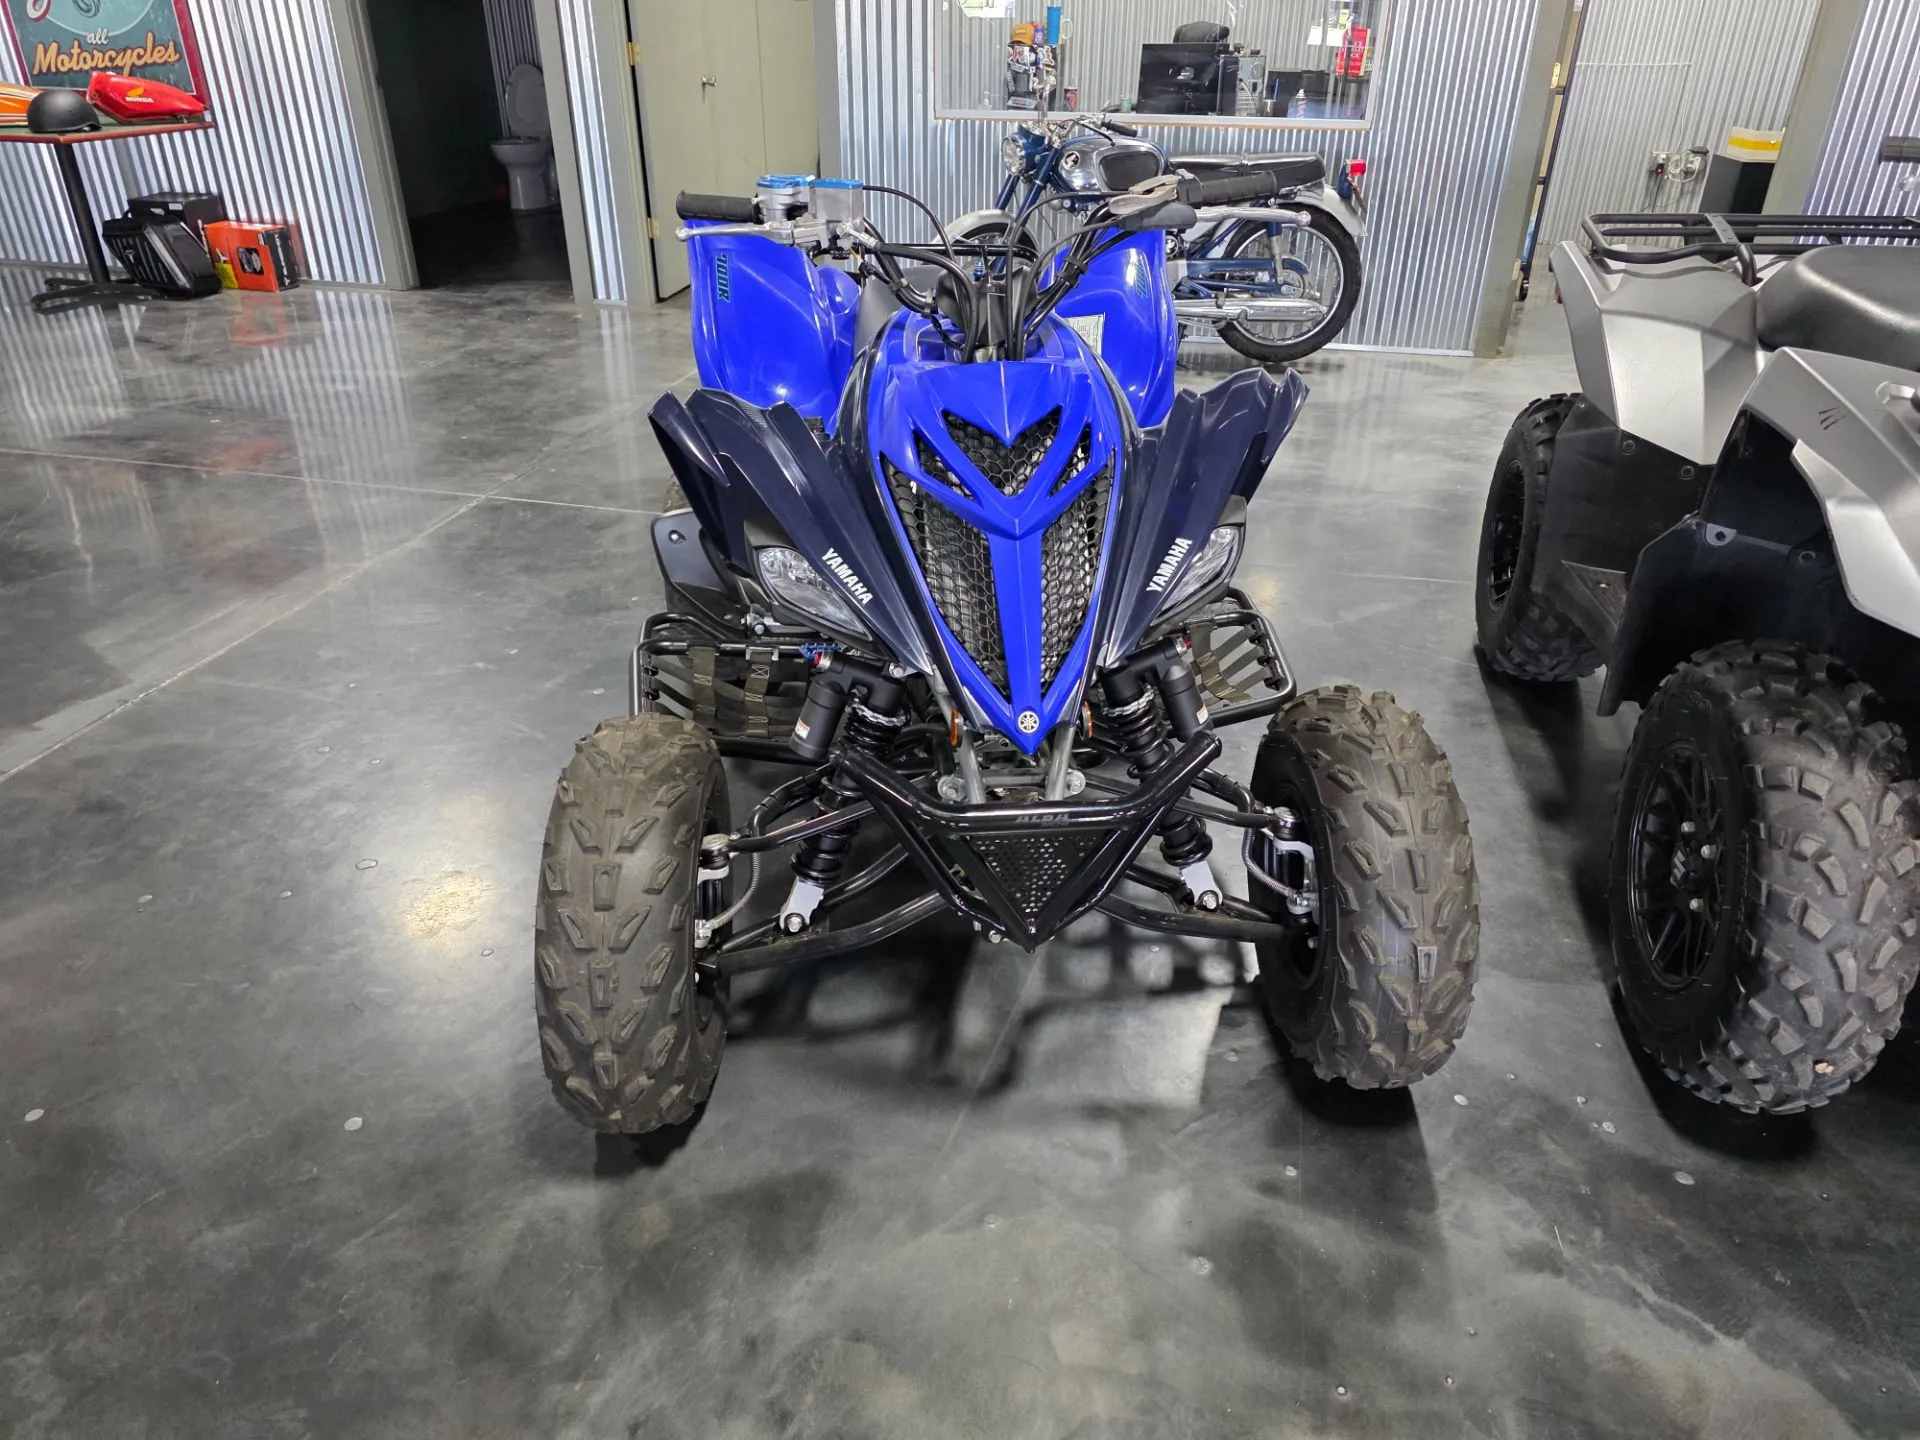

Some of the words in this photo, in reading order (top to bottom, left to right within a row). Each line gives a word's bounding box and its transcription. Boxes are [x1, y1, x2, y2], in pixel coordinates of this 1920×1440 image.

[33, 32, 180, 75] Motorcycles
[86, 28, 109, 44] all
[821, 547, 873, 605] YAMAHA
[1146, 537, 1192, 592] YAMAHA
